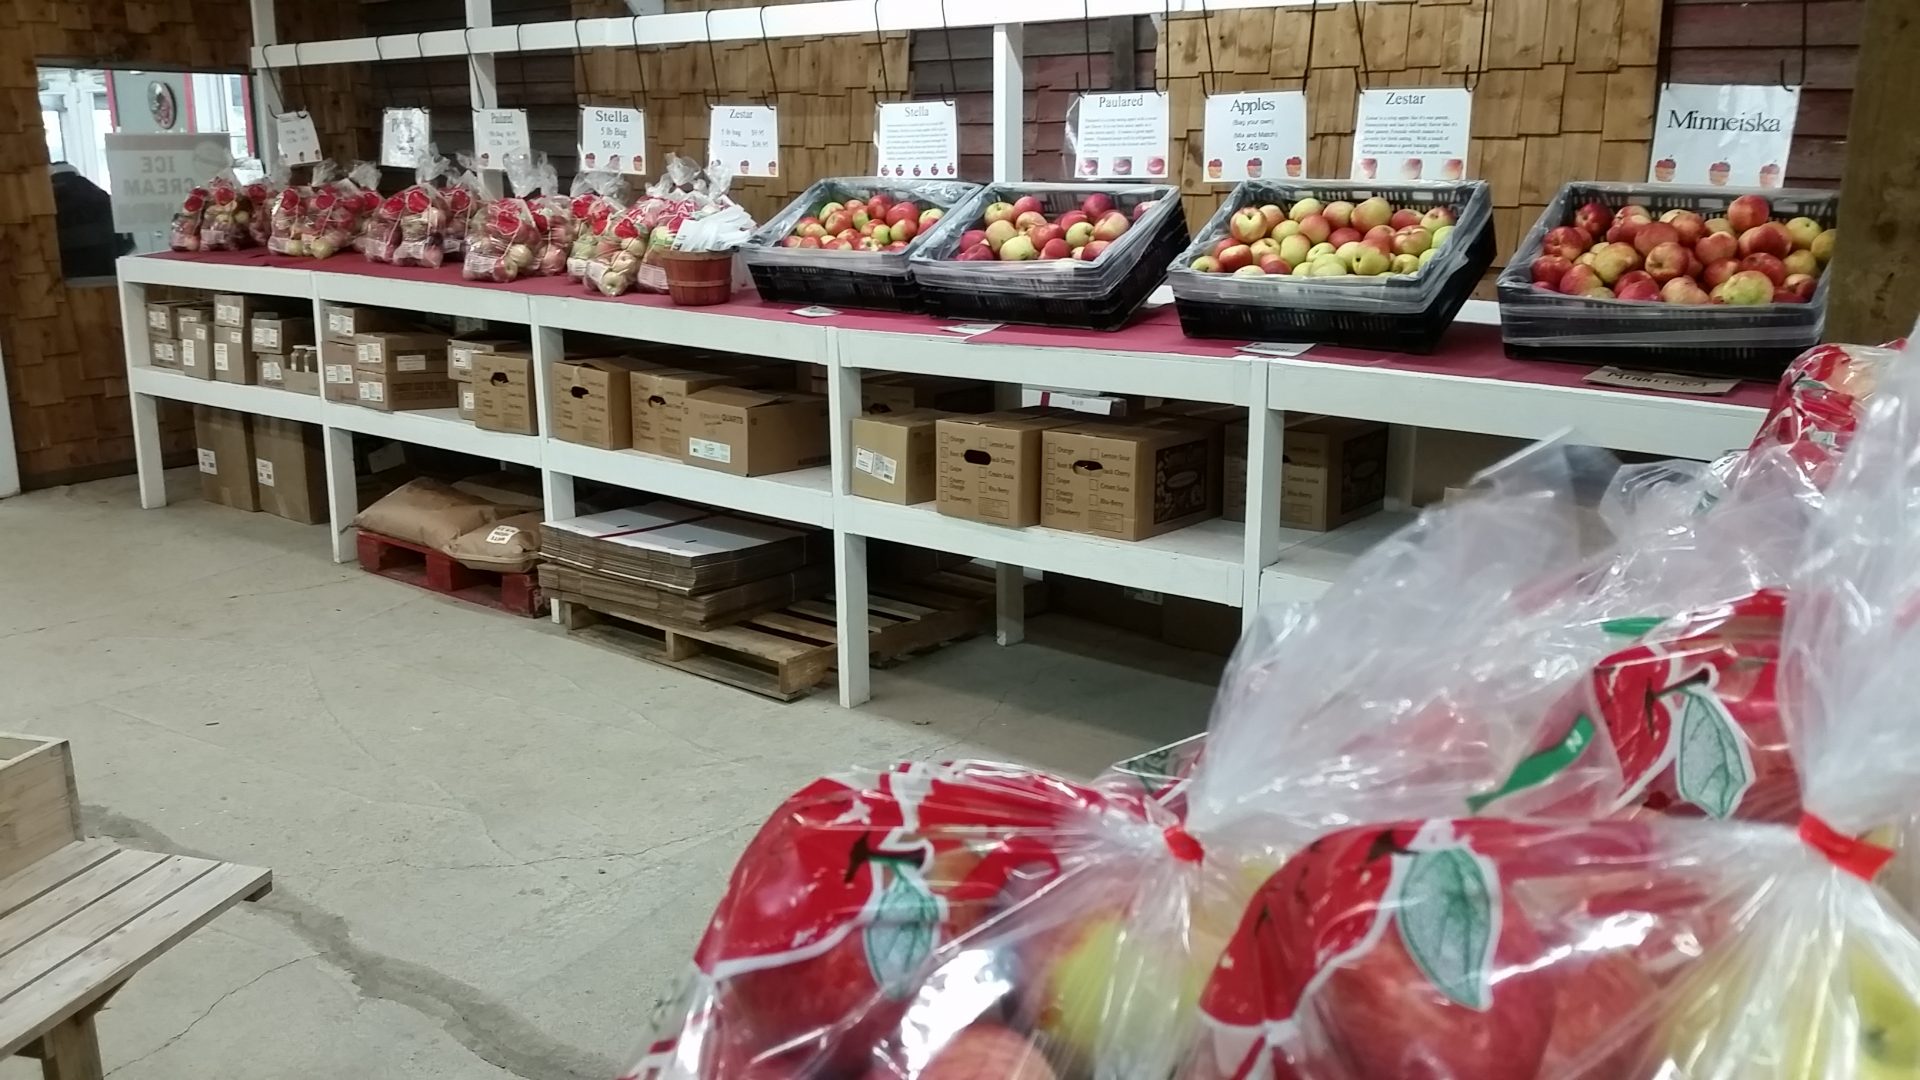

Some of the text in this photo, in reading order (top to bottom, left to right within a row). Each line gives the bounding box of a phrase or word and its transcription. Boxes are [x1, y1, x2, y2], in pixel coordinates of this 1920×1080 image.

[1099, 95, 1144, 108] Paulared
[1385, 92, 1426, 105] Zestar
[904, 106, 930, 117] Stella
[1230, 97, 1276, 115] Apples
[595, 110, 630, 122] Stella
[1667, 109, 1781, 132] Minneiska
[614, 127, 627, 138] Bag
[1057, 446, 1075, 455] Orange
